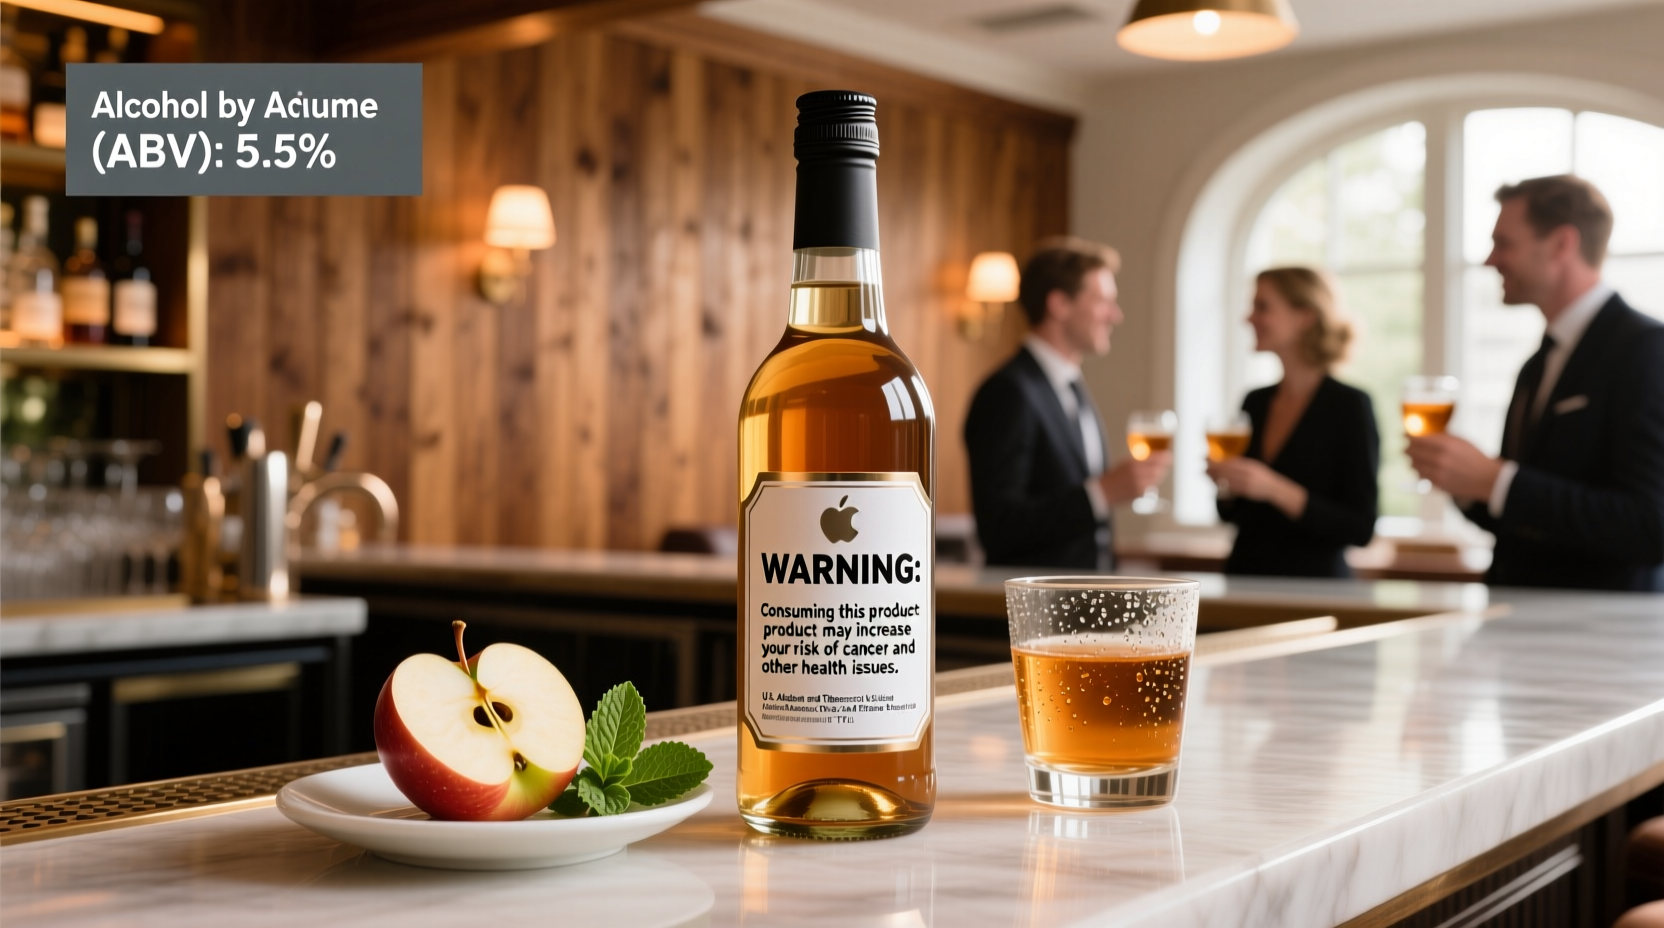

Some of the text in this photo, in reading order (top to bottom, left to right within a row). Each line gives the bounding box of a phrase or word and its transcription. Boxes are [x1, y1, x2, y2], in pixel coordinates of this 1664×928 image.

[761, 553, 920, 584] WARNING:
[761, 603, 919, 622] Consuming this product
[763, 622, 911, 640] product may increase
[762, 639, 915, 658] your risk of cancer and
[762, 659, 899, 675] other health issues.
